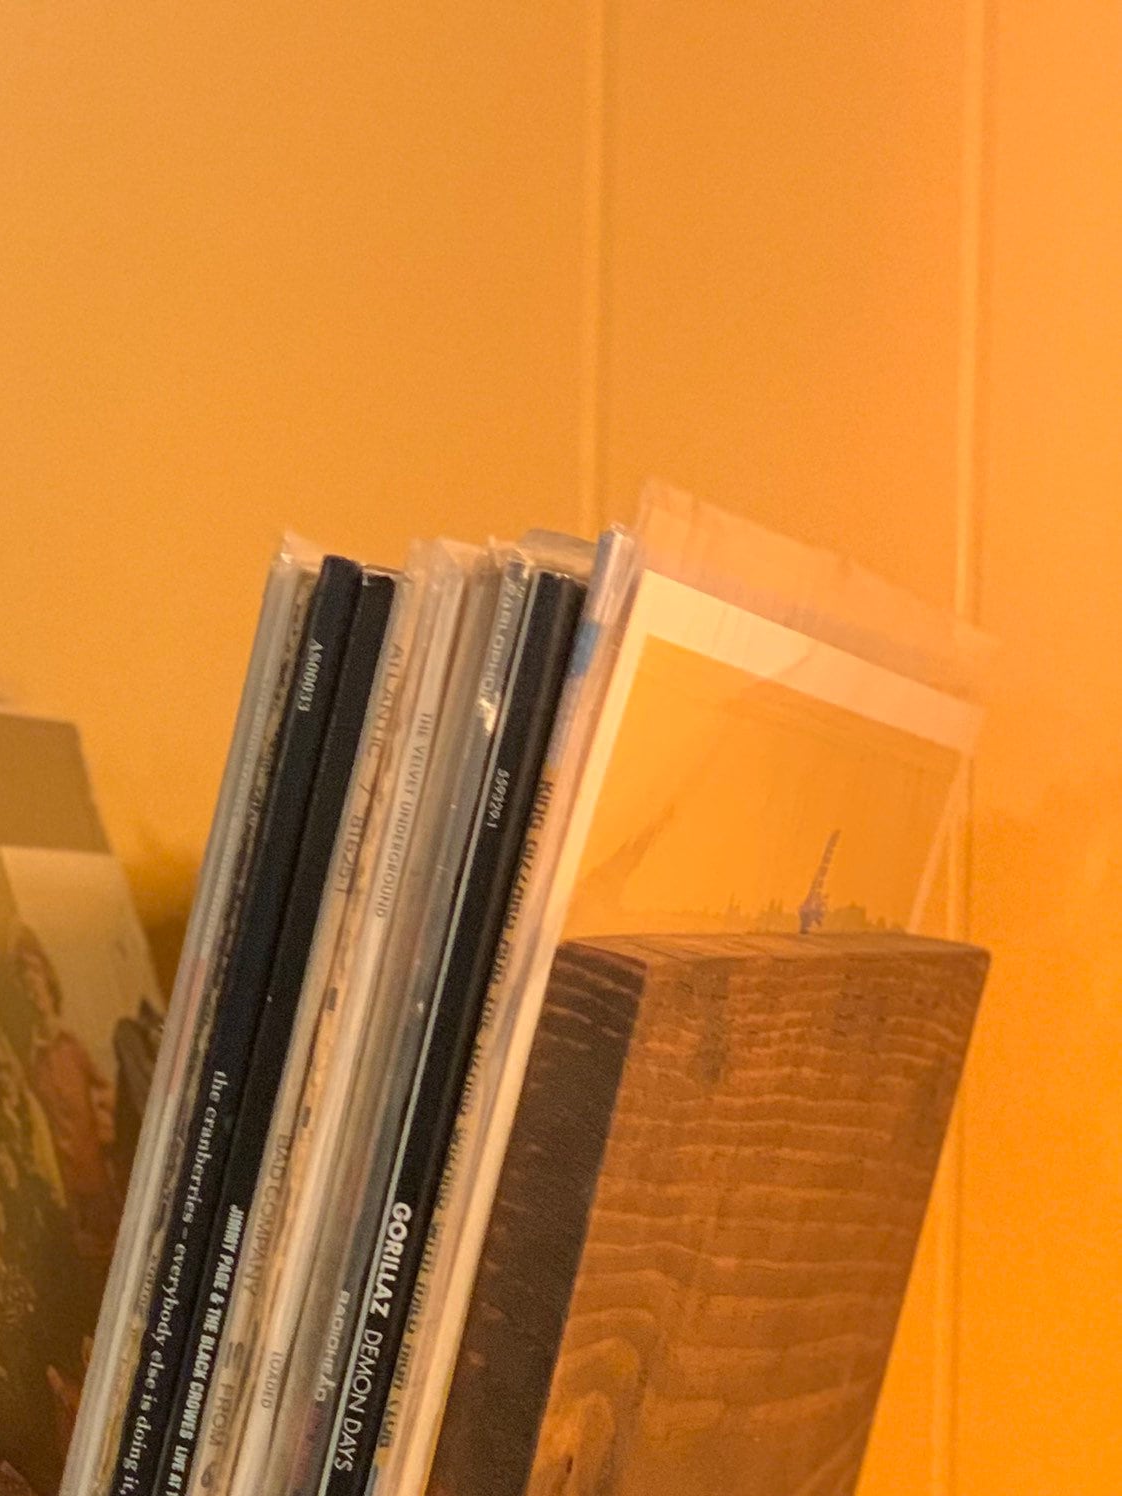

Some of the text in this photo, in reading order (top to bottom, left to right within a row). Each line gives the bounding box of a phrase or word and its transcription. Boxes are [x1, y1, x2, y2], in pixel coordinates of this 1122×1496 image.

[365, 642, 405, 759] ATLANTIC
[374, 711, 431, 919] THE VELVET UNDERGROUND
[207, 1070, 229, 1103] the
[181, 1105, 221, 1225] cranberries
[219, 1203, 245, 1253] JIMMY
[149, 1242, 190, 1347] everybody
[207, 1132, 290, 1448] BAD COMPANY FROM
[211, 1253, 234, 1291] PAGE
[201, 1307, 221, 1334] THE
[208, 1291, 225, 1305] &
[191, 1334, 215, 1380] BLACK
[314, 1289, 351, 1403] RADIOHEAD
[332, 1200, 413, 1473] GORILLAZ DEMON DAYS
[144, 1349, 167, 1390] else
[259, 1351, 282, 1409] LOADED
[139, 1393, 157, 1412] is
[177, 1380, 204, 1440] CROWES
[121, 1414, 153, 1474] doing
[170, 1444, 189, 1472] LIVE
[118, 1474, 140, 1496] it,
[166, 1472, 182, 1489] AT
